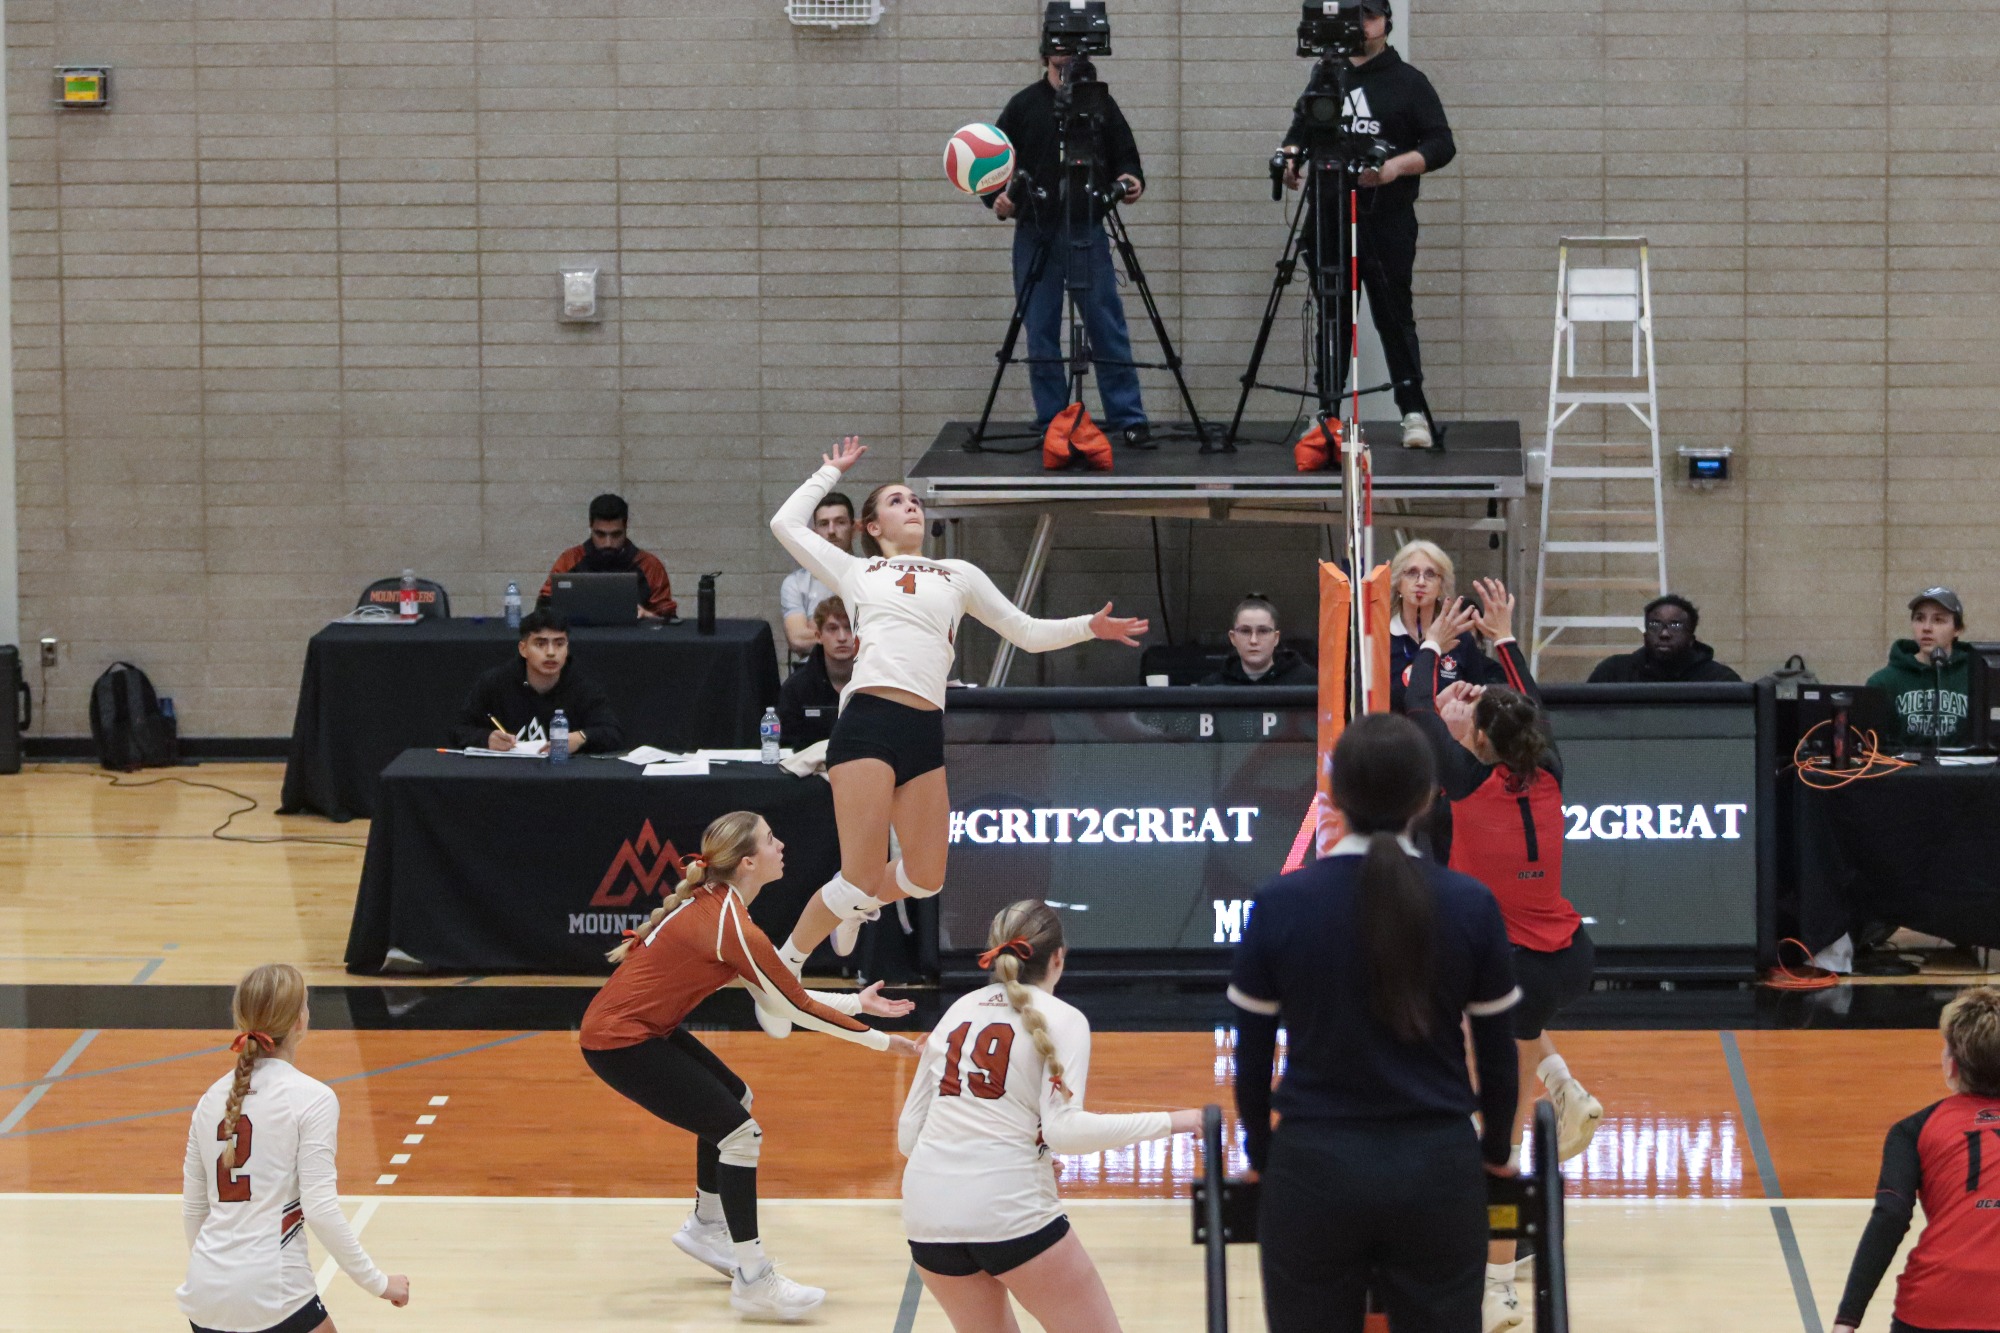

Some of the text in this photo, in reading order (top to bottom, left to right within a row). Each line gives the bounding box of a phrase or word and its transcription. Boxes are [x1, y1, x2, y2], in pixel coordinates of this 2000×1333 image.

[370, 590, 435, 603] MOUNTERS
[895, 573, 916, 595] 4
[1896, 689, 1969, 717] MICHGAN
[1200, 712, 1277, 737] B P
[1907, 714, 1957, 736] STATE
[948, 807, 1259, 843] #GRIT2GREAT
[1561, 803, 1748, 840] 2GREAT
[938, 1022, 1016, 1100] 19
[216, 1114, 253, 1202] 2
